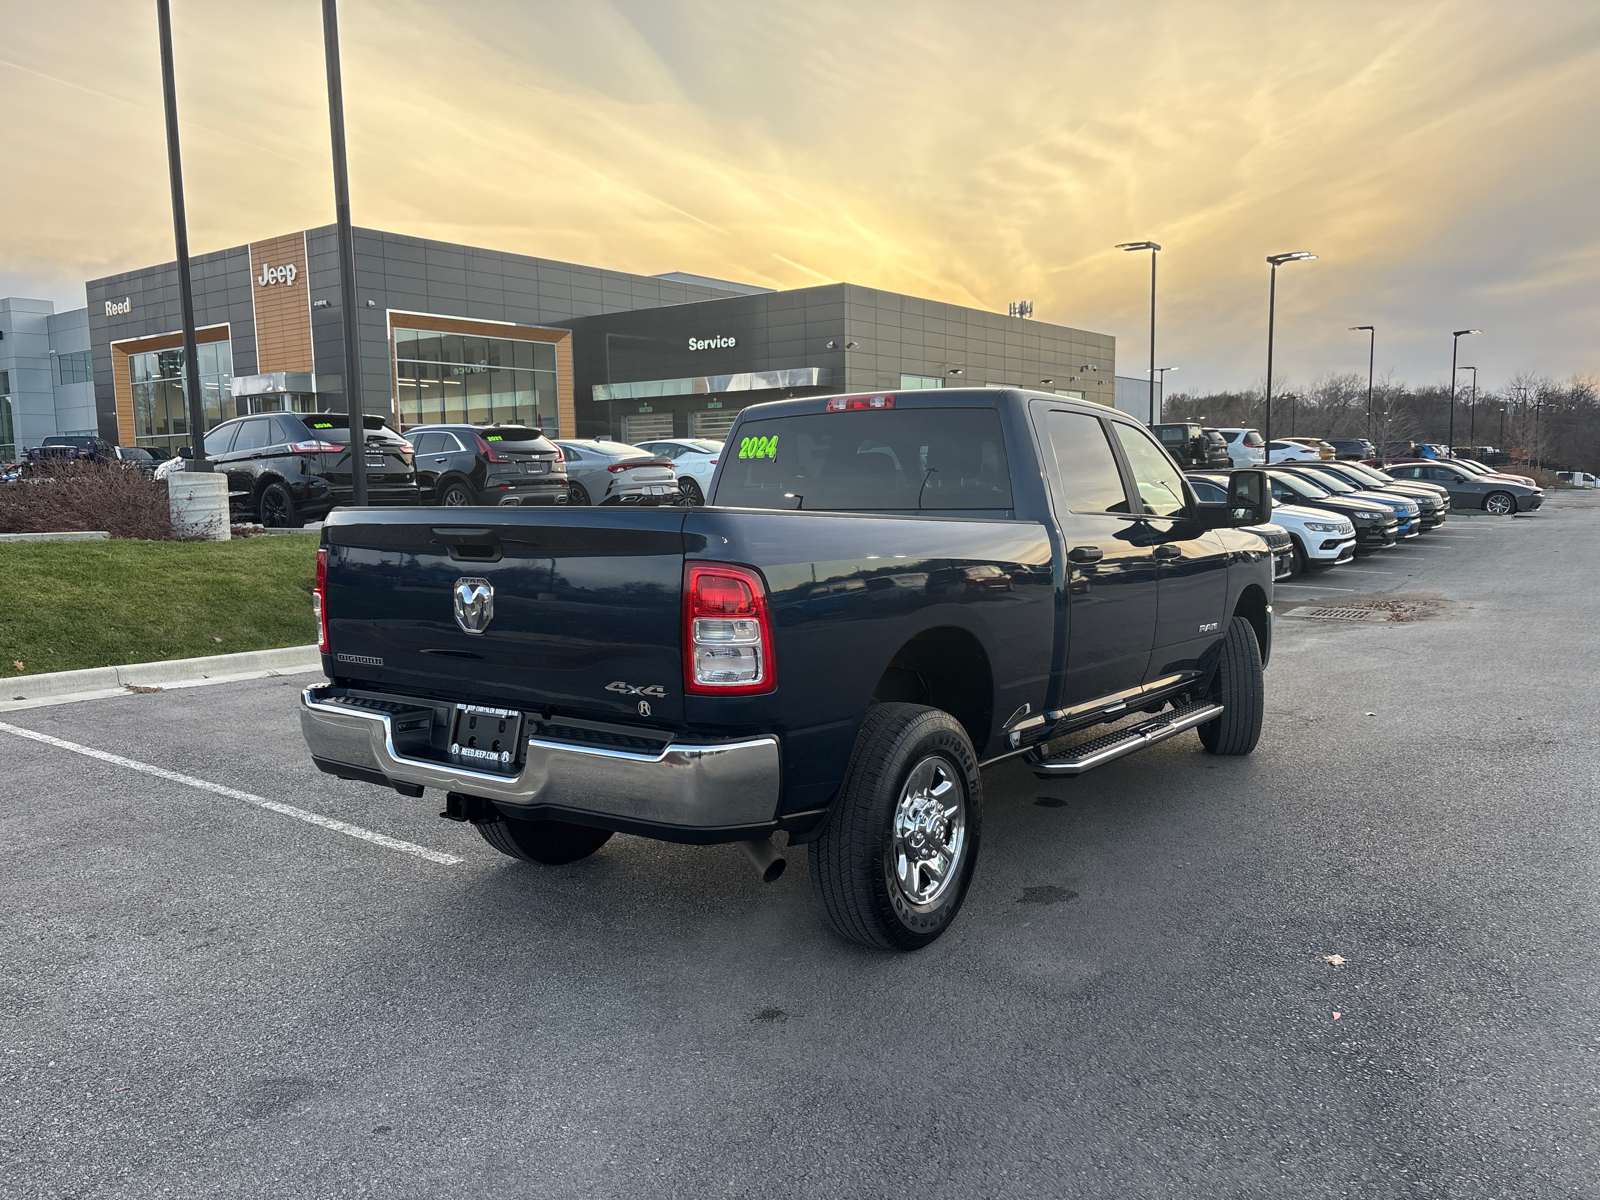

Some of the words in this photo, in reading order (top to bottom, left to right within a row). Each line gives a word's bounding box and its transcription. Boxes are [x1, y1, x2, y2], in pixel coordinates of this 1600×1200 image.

[258, 263, 297, 287] Jeep
[105, 297, 131, 317] Reed
[688, 335, 736, 351] Service
[739, 435, 779, 459] 2024
